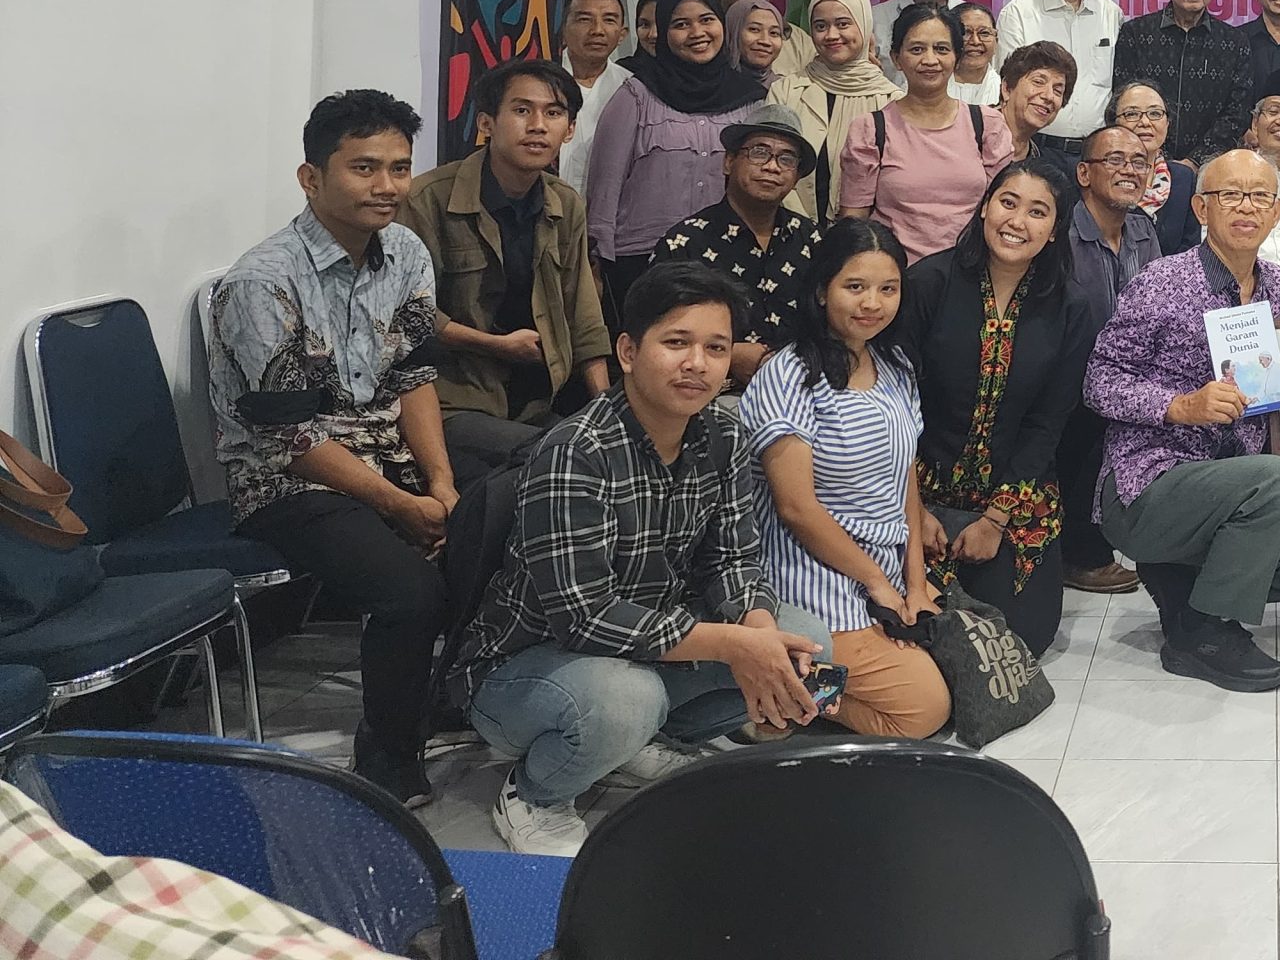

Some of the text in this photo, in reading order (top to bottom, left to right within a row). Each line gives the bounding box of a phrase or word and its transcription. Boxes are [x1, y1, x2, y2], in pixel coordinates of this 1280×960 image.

[1220, 317, 1259, 332] Menjadi
[1225, 330, 1259, 342] Garam
[1229, 342, 1260, 354] Dunia
